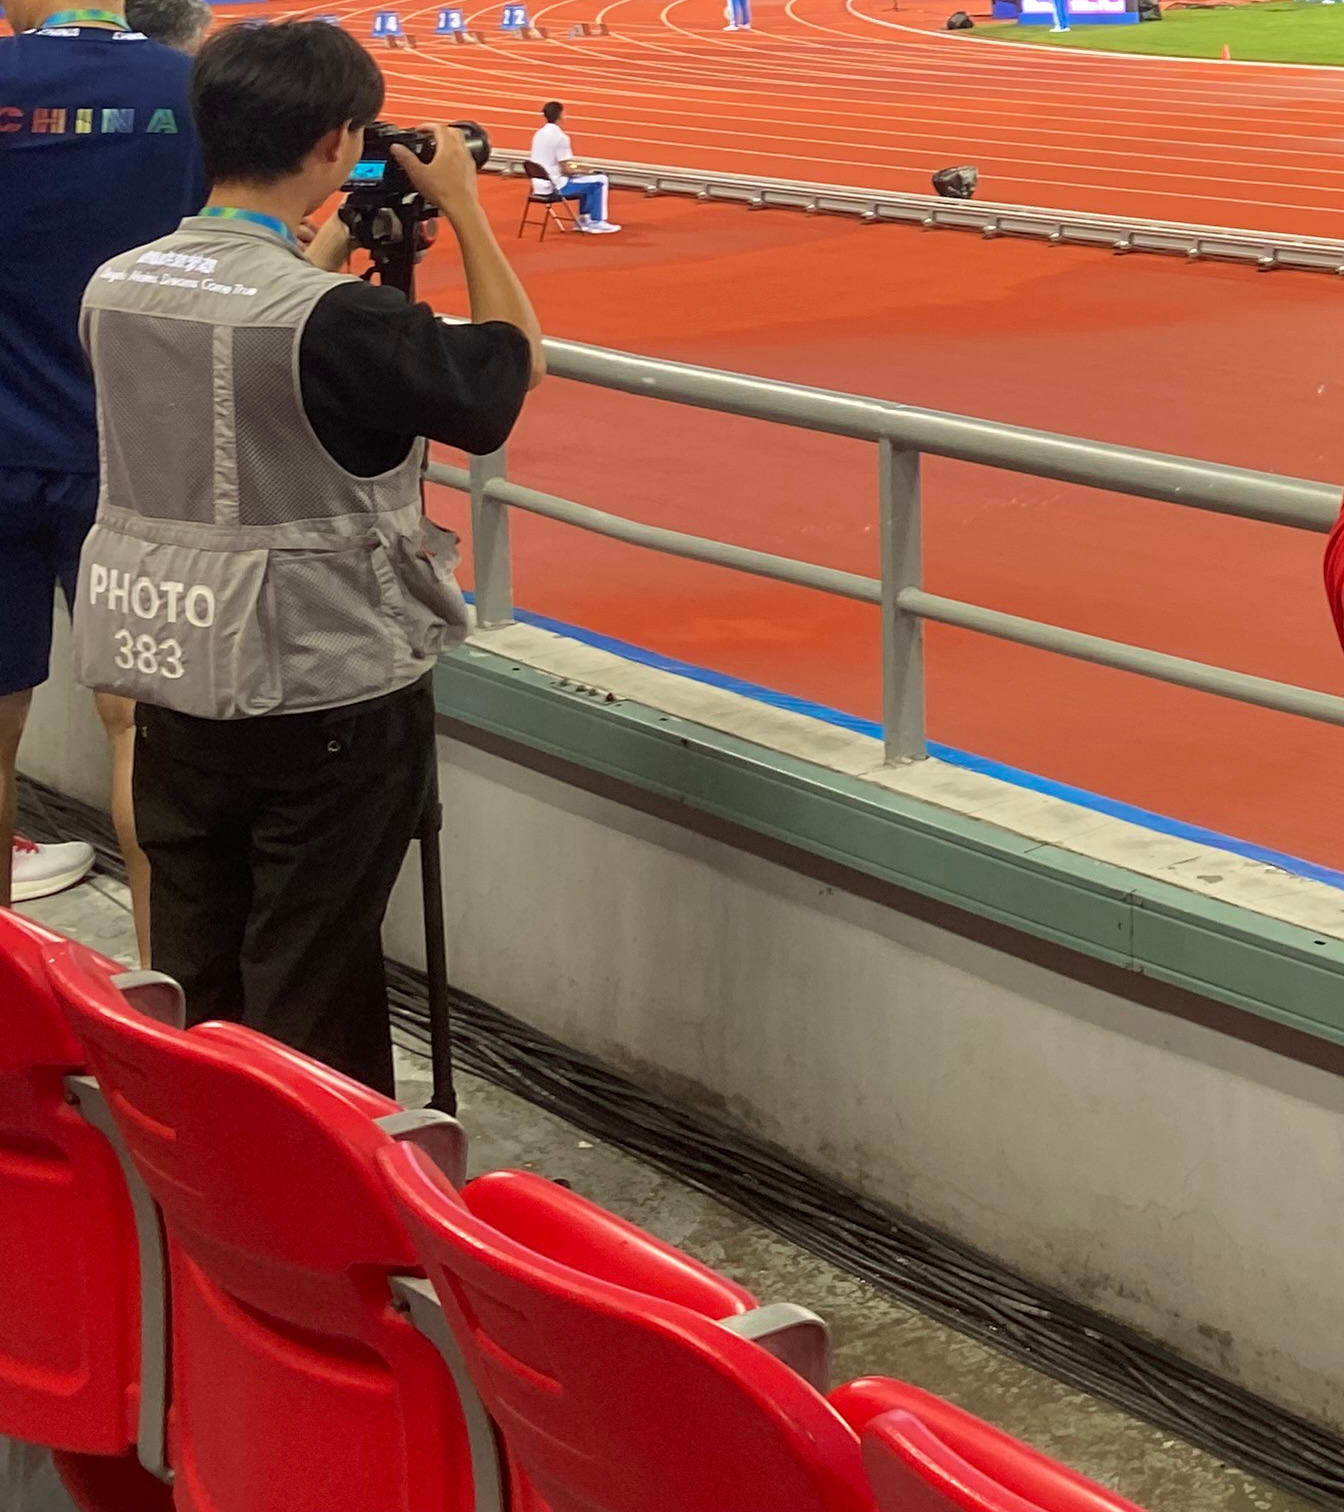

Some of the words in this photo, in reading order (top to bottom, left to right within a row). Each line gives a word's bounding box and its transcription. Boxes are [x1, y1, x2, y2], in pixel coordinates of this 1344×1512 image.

[503, 9, 526, 25] 12
[0, 106, 178, 134] CHINA
[90, 563, 215, 627] PHOTO
[114, 629, 185, 678] 383
